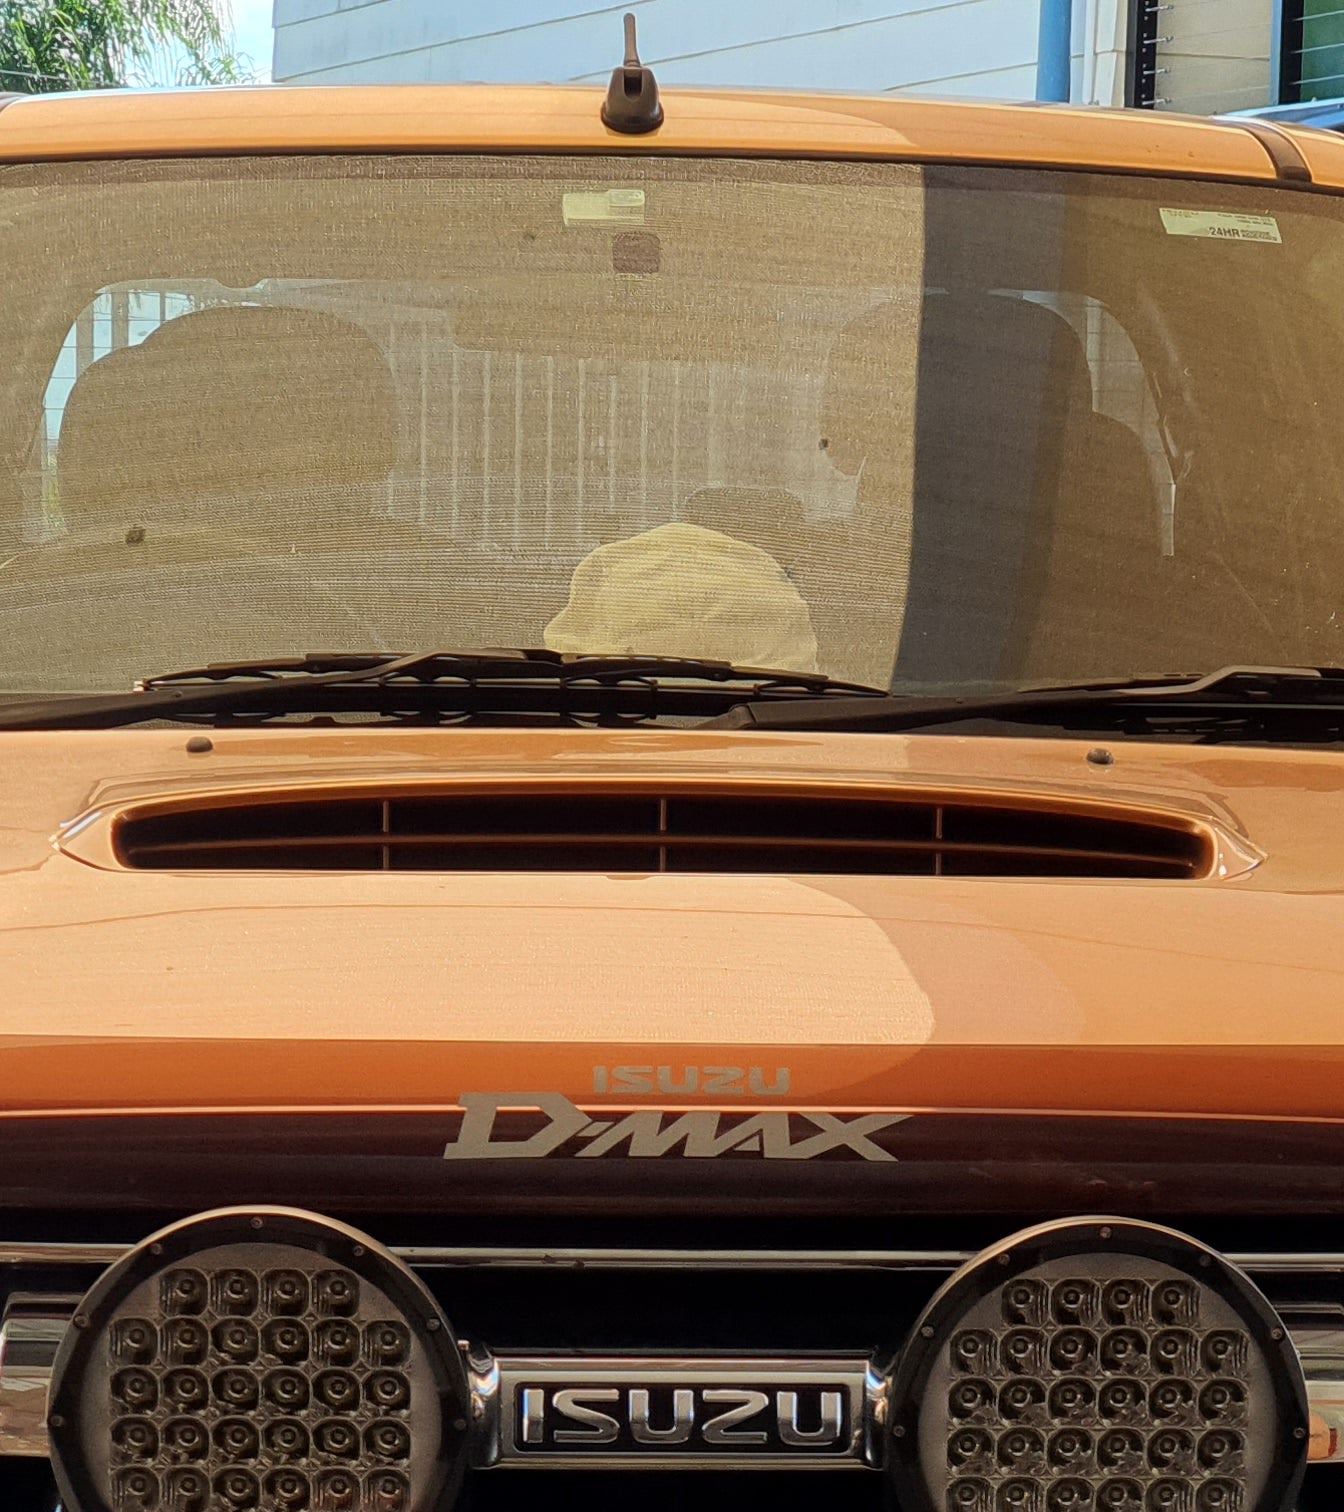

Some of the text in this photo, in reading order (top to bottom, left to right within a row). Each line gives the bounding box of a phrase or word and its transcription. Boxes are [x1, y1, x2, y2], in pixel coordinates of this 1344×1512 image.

[592, 1065, 791, 1096] ISUZU
[443, 1091, 915, 1162] D-MAX
[522, 1387, 843, 1447] ISUZU
